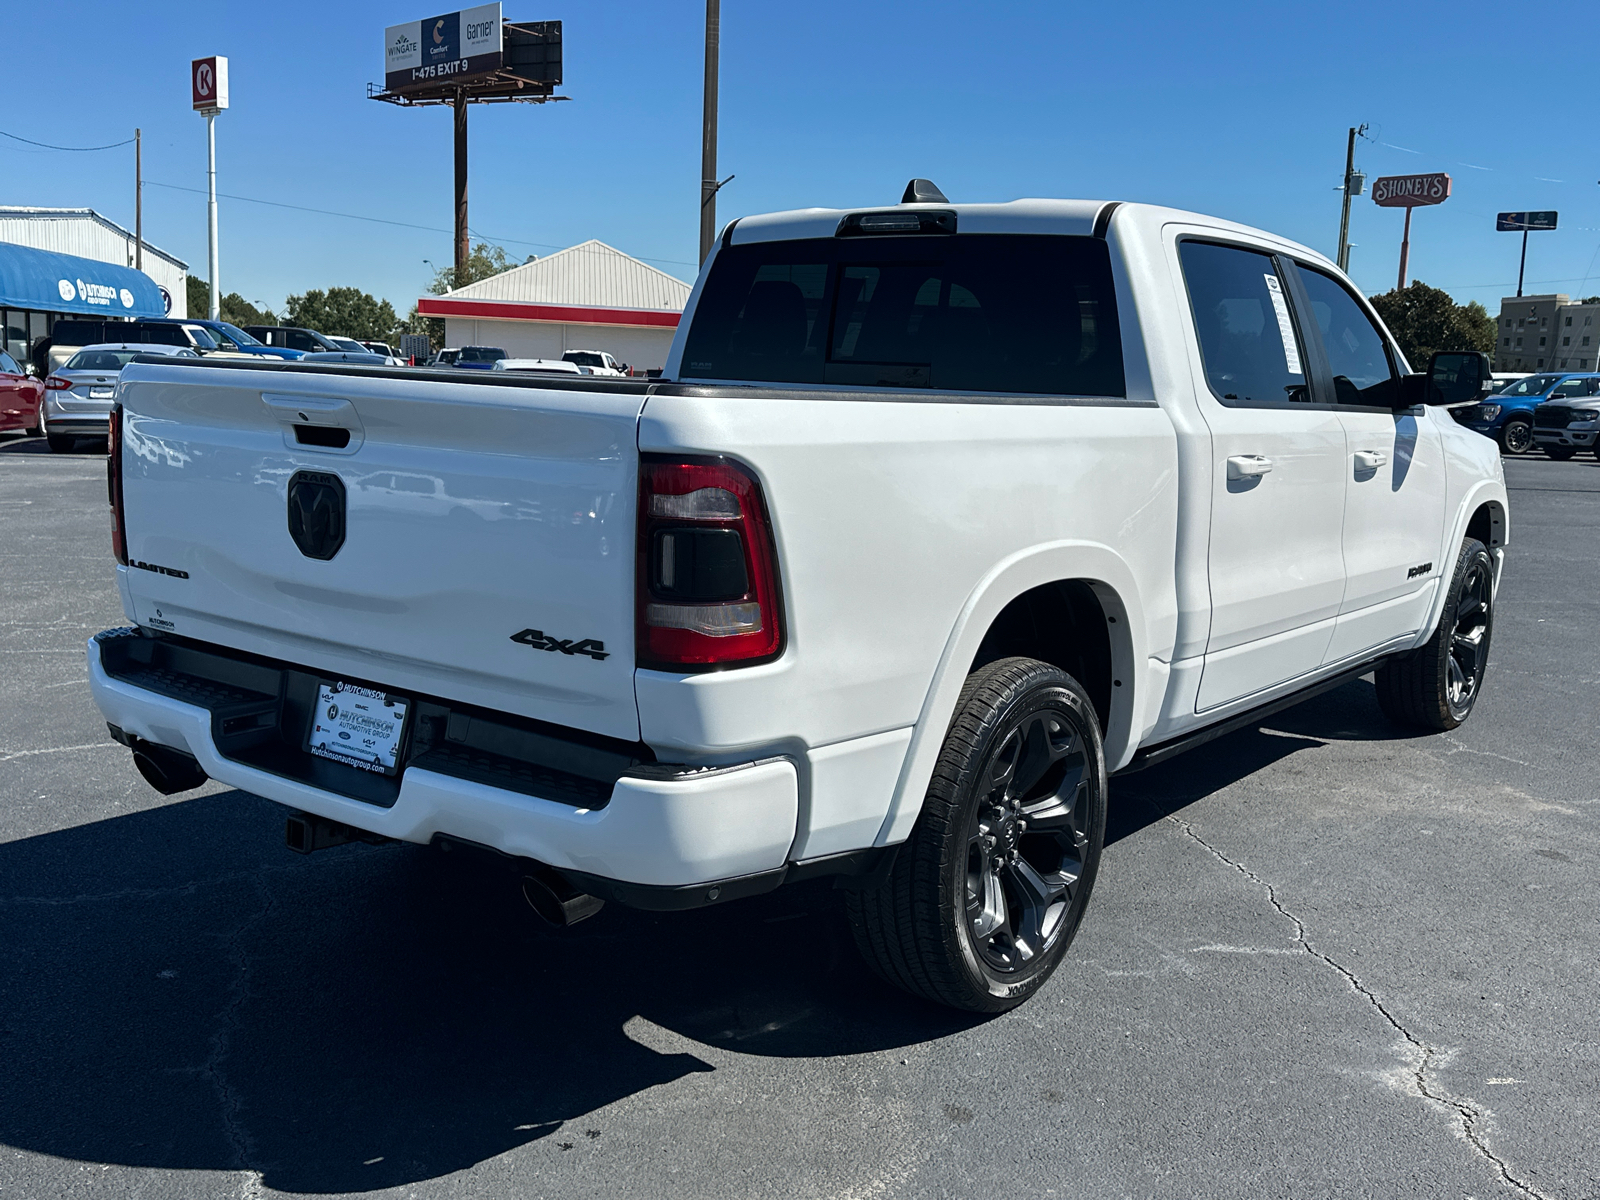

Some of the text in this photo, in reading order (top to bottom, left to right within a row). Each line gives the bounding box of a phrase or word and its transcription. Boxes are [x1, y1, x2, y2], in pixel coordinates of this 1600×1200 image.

[466, 20, 494, 40] Garner
[388, 42, 417, 57] WINGATE
[429, 45, 449, 55] Comfort
[412, 59, 469, 80] I-475 EXIT 9
[200, 69, 211, 92] K
[1376, 176, 1443, 200] SHONEY'S
[298, 474, 331, 483] RAM
[344, 684, 386, 700] HUTCHINSON
[339, 710, 394, 732] HUTCHINSON
[339, 721, 391, 740] AUTOMOTIVE GROUP
[311, 747, 384, 773] Hutchinsonautogroup.com
